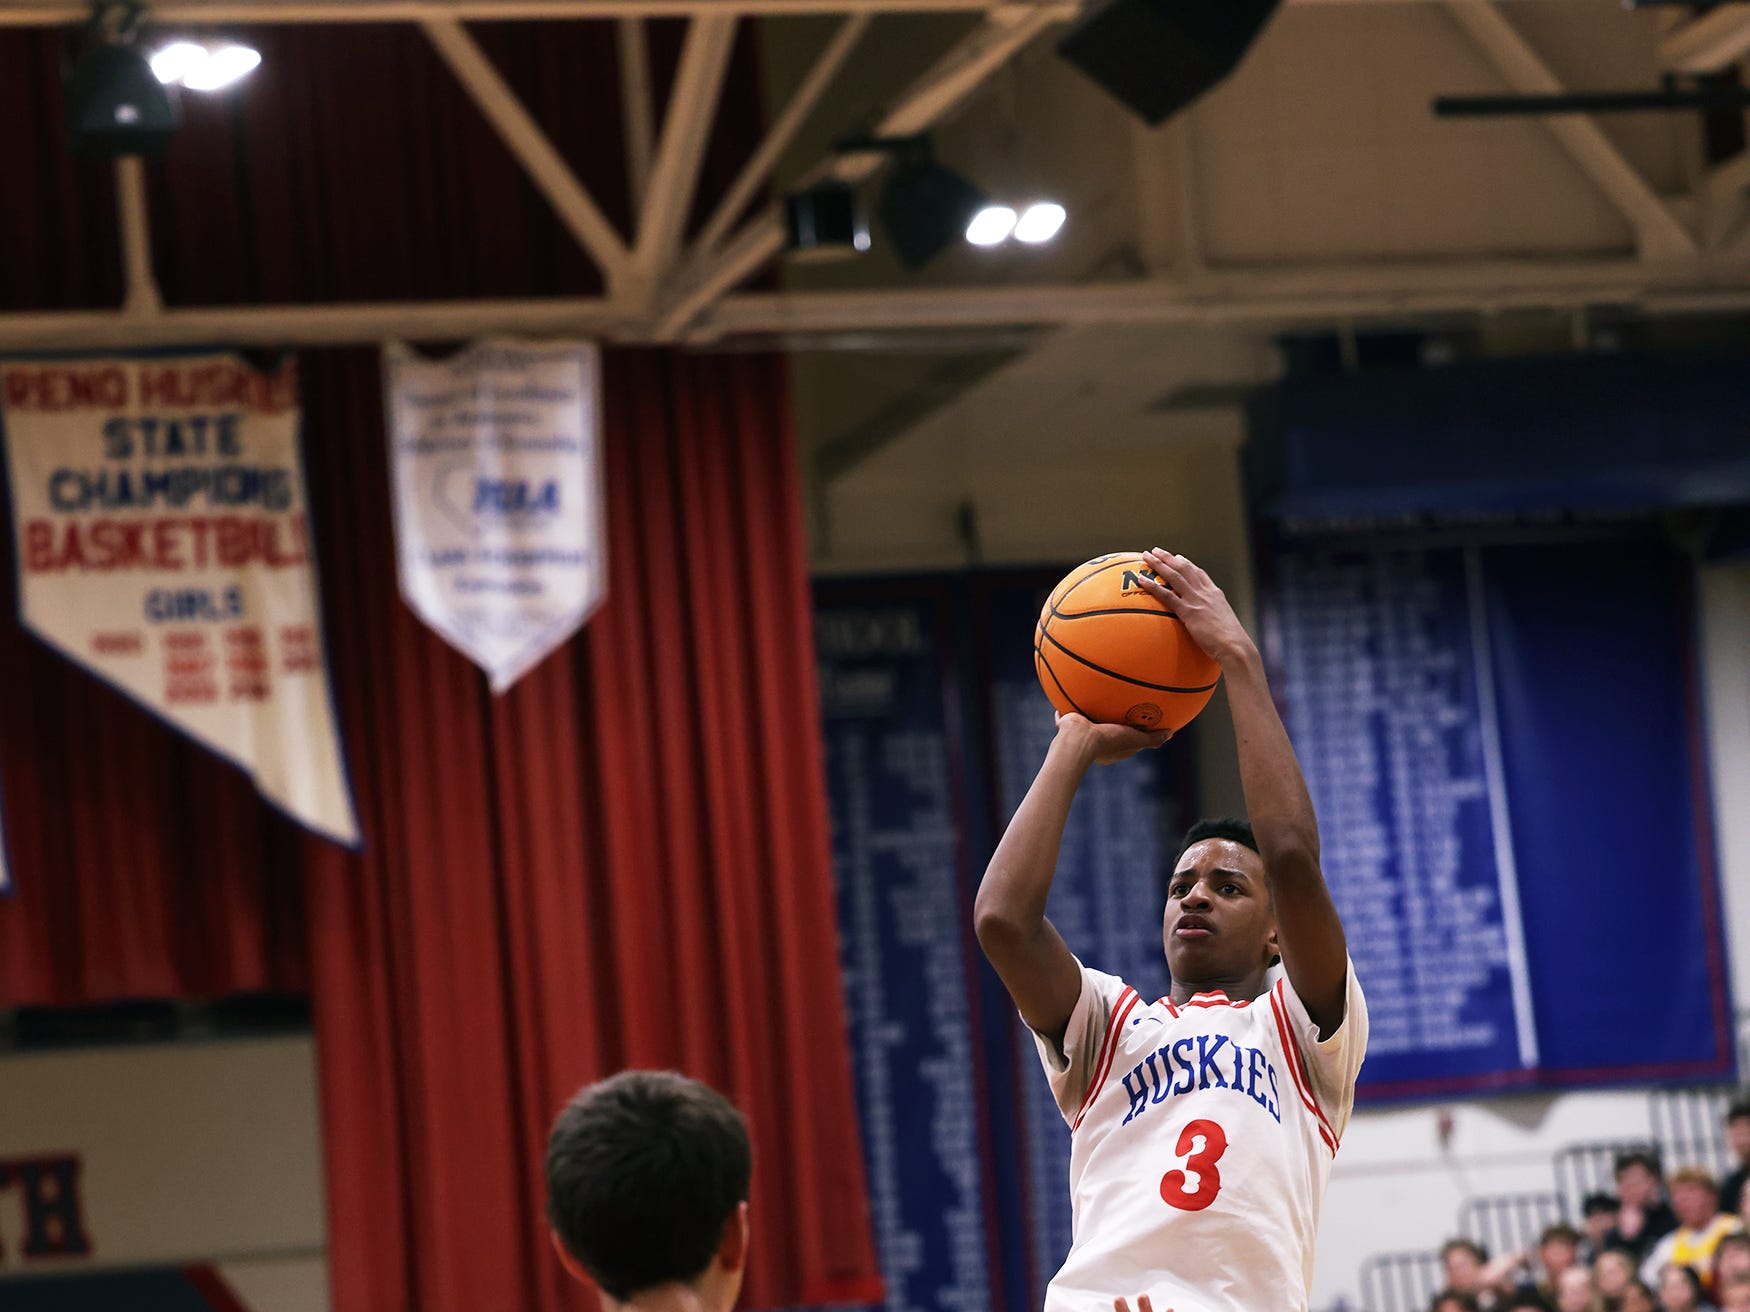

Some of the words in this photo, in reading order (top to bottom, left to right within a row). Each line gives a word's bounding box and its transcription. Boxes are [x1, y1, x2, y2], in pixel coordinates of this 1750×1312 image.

[102, 414, 242, 460] STATE
[48, 465, 291, 513] CHAMPIONS
[1122, 1034, 1281, 1127] HUSKIES
[1160, 1119, 1229, 1212] 3
